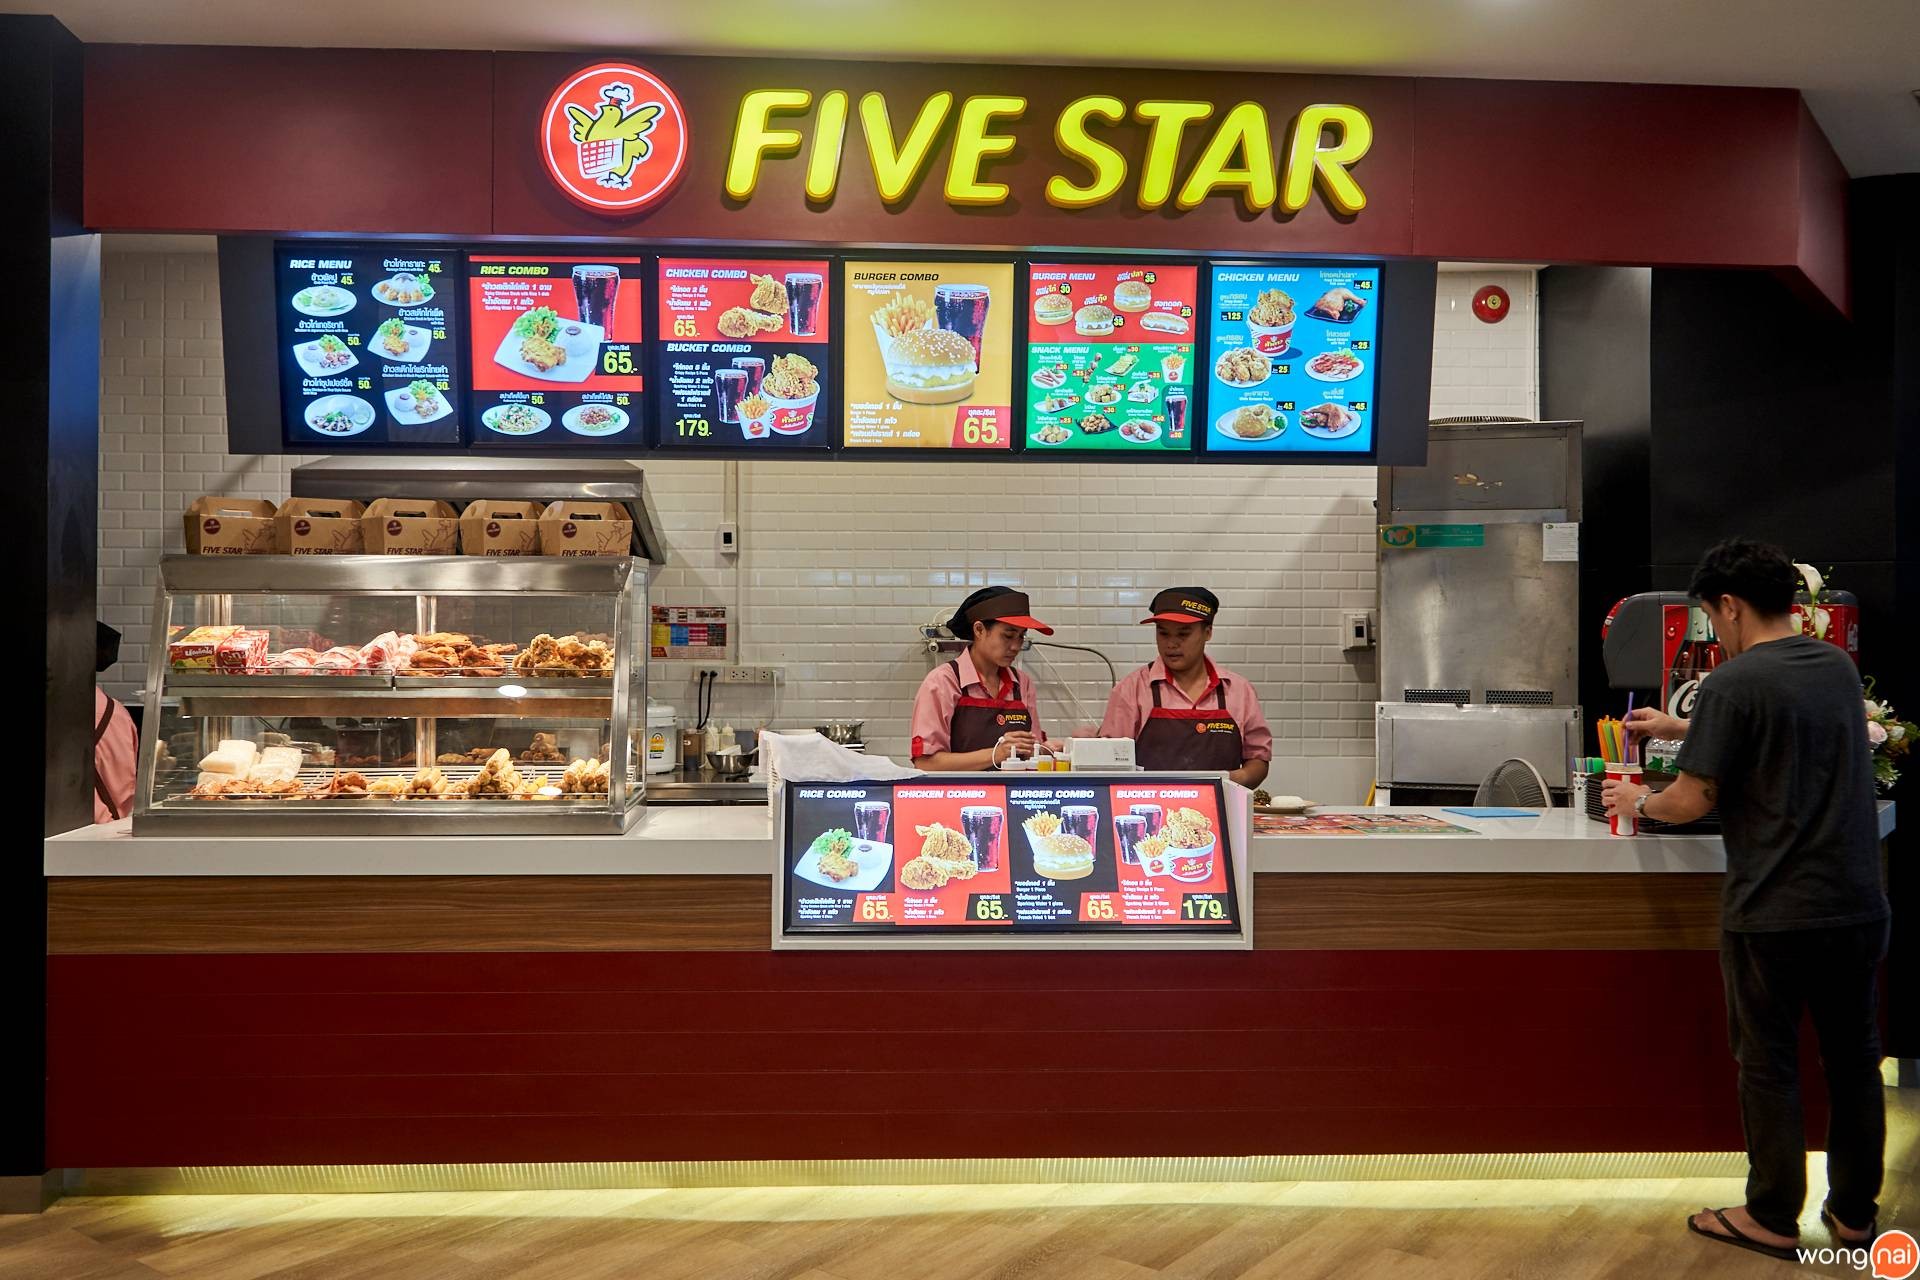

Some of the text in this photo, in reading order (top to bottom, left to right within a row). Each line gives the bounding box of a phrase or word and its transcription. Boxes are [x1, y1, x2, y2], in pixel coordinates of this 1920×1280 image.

[725, 88, 1374, 215] FIVE STAR
[290, 260, 352, 269] RICE MENU
[480, 266, 549, 275] RICE COMBO
[666, 269, 747, 279] CHICKEN COMBO
[854, 272, 939, 281] BURGER COMBO
[1032, 272, 1066, 280] BURGER
[1218, 273, 1300, 282] CHICKEN MENU
[667, 343, 752, 353] BUCKET COMBO
[1031, 346, 1089, 354] SNACK MENU
[202, 546, 243, 555] FIVE STAR
[294, 547, 312, 555] FIVE
[387, 547, 403, 555] FIVE
[562, 549, 579, 557] FIVE
[1181, 599, 1198, 609] FIVE
[800, 790, 866, 799] RICE COMBO
[897, 790, 986, 799] CHICKEN COMBO
[1010, 790, 1095, 799] BURGER COMBO
[1116, 790, 1199, 799] BUCKET COMBO
